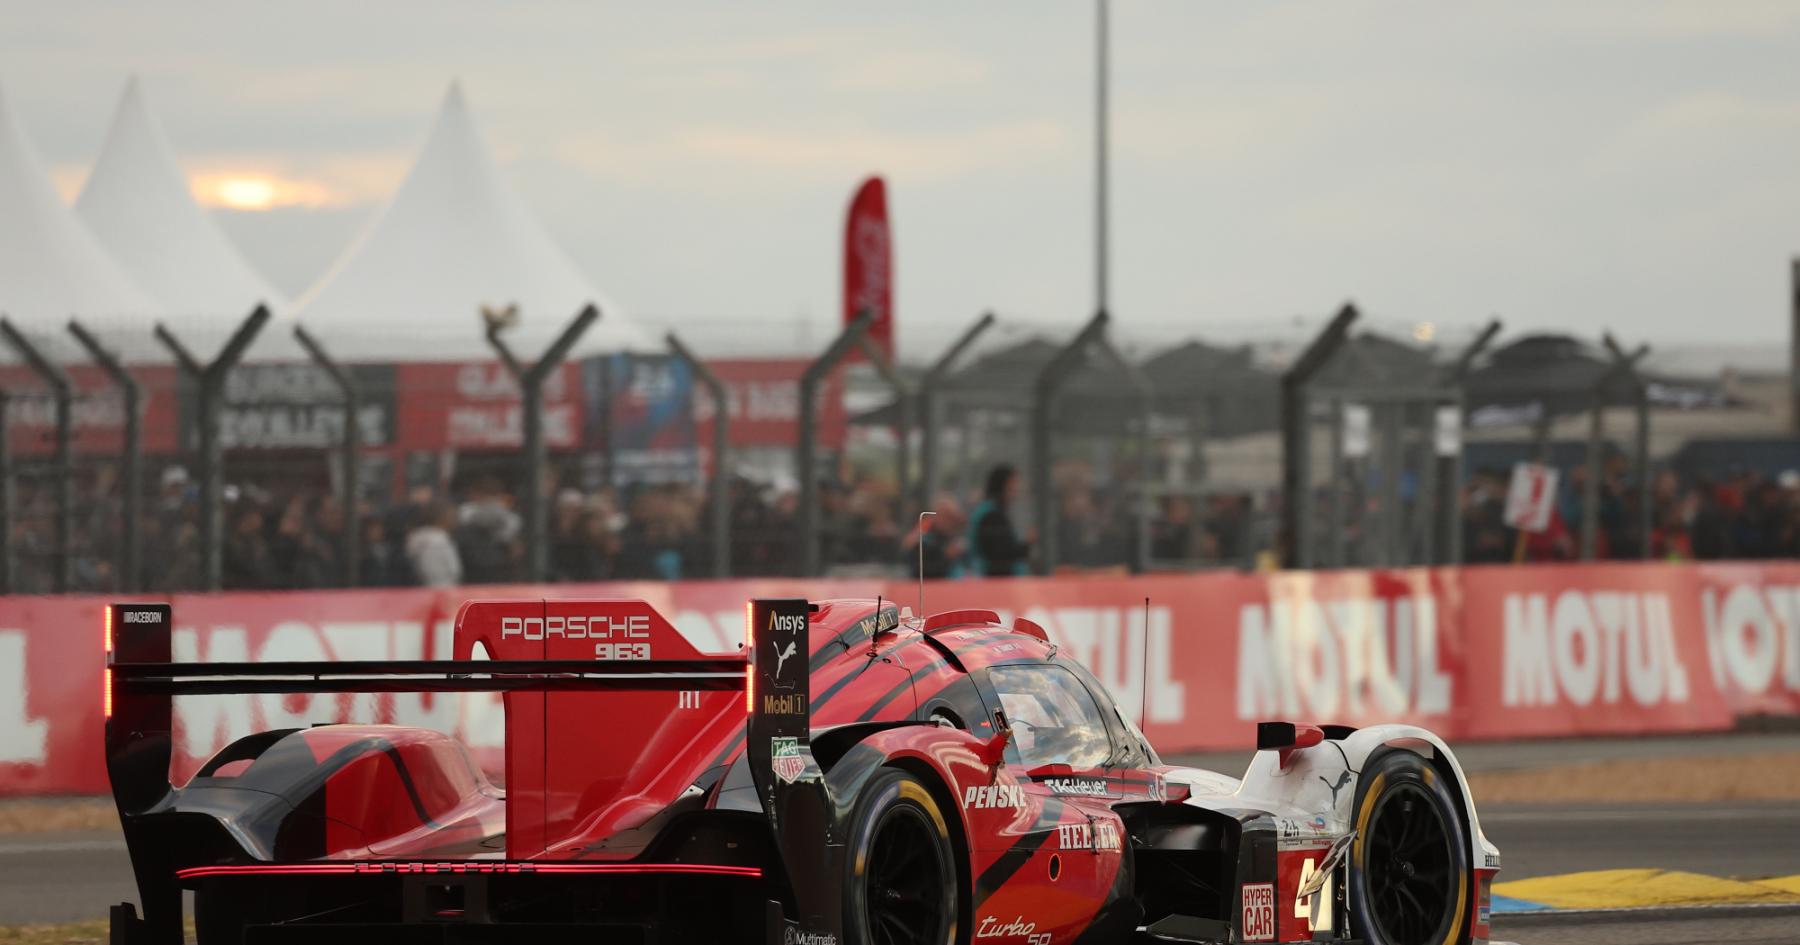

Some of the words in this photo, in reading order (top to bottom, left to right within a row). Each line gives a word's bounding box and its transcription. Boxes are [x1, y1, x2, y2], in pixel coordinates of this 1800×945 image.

[502, 616, 650, 640] PORSCHE
[768, 610, 805, 635] Ansys
[595, 643, 651, 660] 963
[1237, 599, 1453, 719] MOTUL
[1503, 590, 1688, 706] MOTUL
[1001, 607, 1184, 723] TUL
[764, 695, 793, 715] Mobil
[774, 741, 798, 756] TAG
[1244, 888, 1272, 907] HYPER
[1244, 906, 1272, 937] CAR
[796, 932, 836, 945] Multimatic
[1028, 933, 1052, 945] 50
